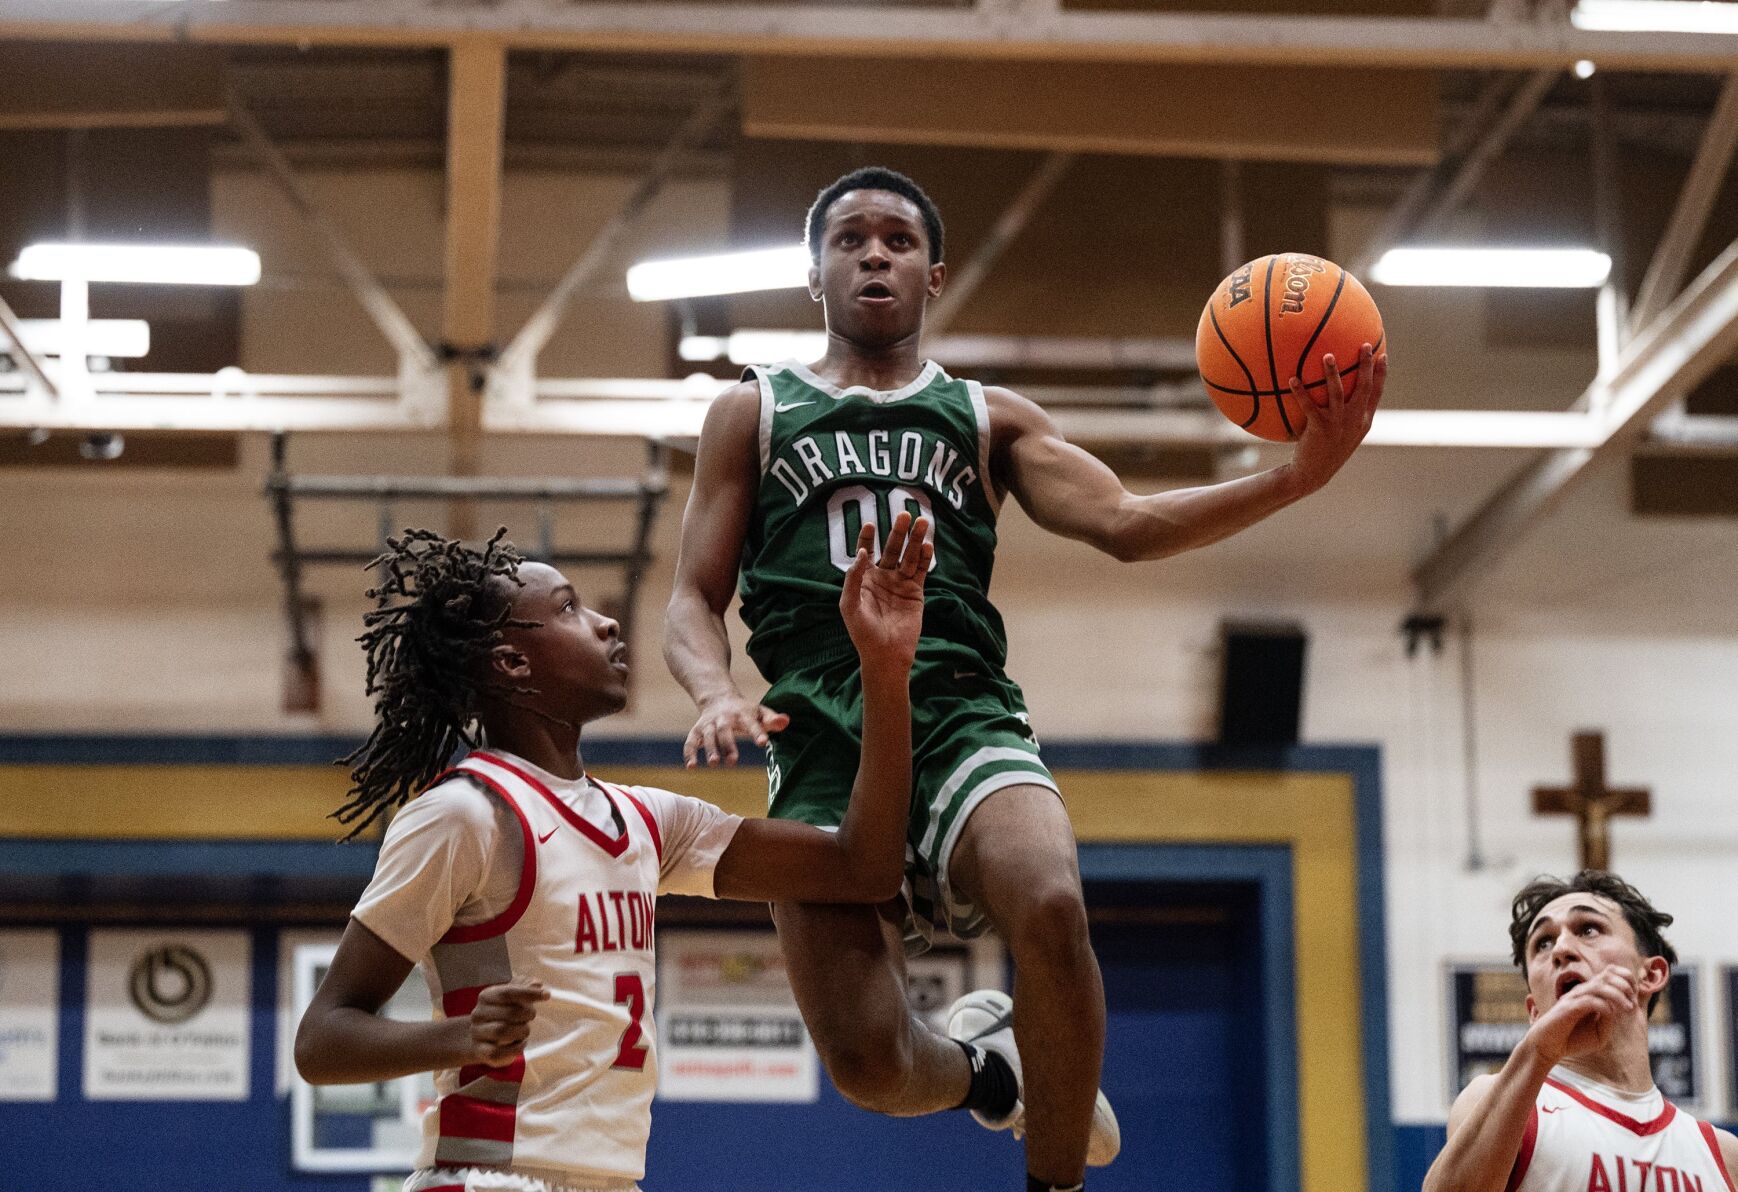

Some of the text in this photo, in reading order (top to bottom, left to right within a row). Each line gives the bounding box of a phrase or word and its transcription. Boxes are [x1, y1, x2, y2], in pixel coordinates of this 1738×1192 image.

[1228, 263, 1252, 310] AA
[1281, 254, 1325, 314] ilson
[770, 429, 977, 511] DRAGONS
[575, 891, 653, 953] ALTON
[609, 971, 649, 1072] 2
